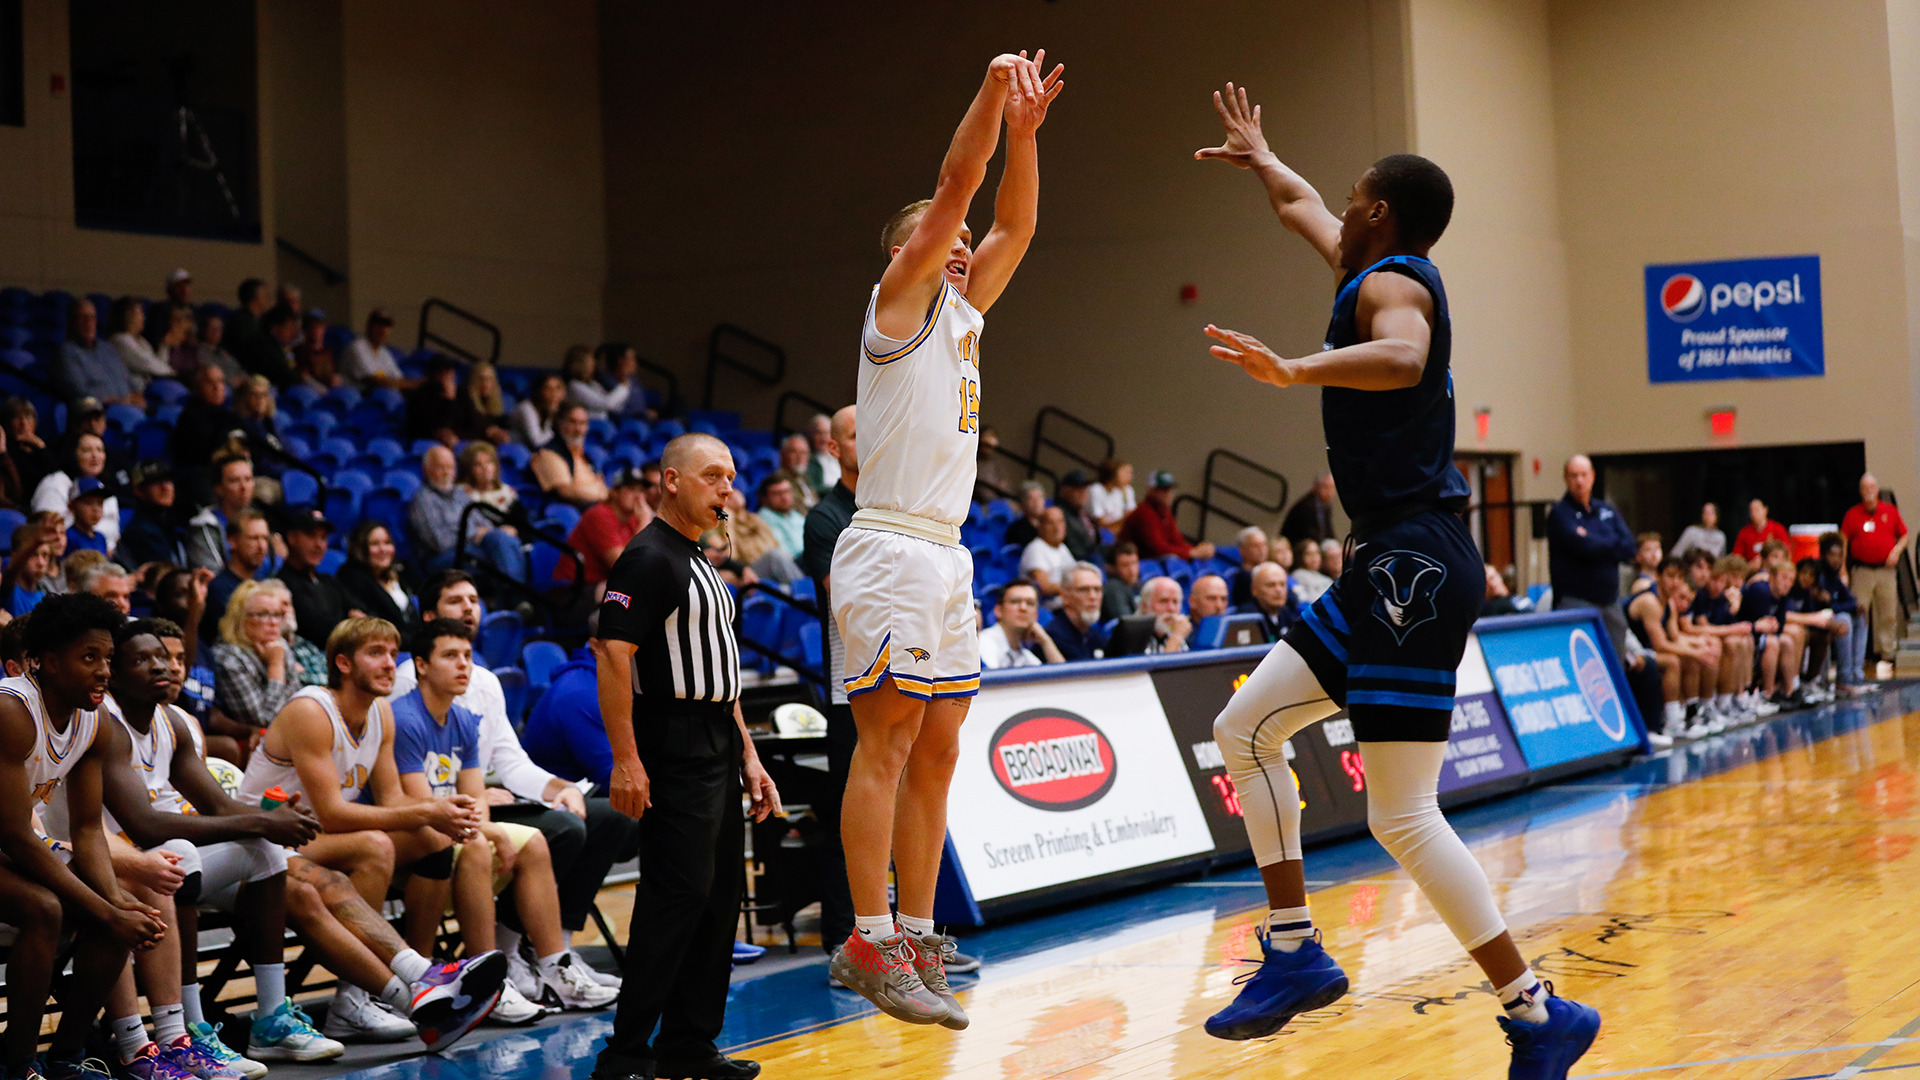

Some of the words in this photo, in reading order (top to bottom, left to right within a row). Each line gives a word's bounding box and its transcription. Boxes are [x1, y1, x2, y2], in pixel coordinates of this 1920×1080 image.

[1710, 273, 1801, 316] pepsi
[1681, 326, 1727, 347] Proud
[1727, 325, 1789, 347] Sponsor
[1678, 350, 1697, 373] of
[1726, 345, 1792, 367] Athletics
[605, 592, 629, 607] NAIA
[1001, 733, 1104, 786] BROADWAY
[1192, 740, 1226, 770] HOM
[983, 841, 1034, 869] Screen
[1034, 825, 1094, 857] Printing
[1093, 822, 1104, 847] &
[1106, 811, 1177, 844] Embroidery
